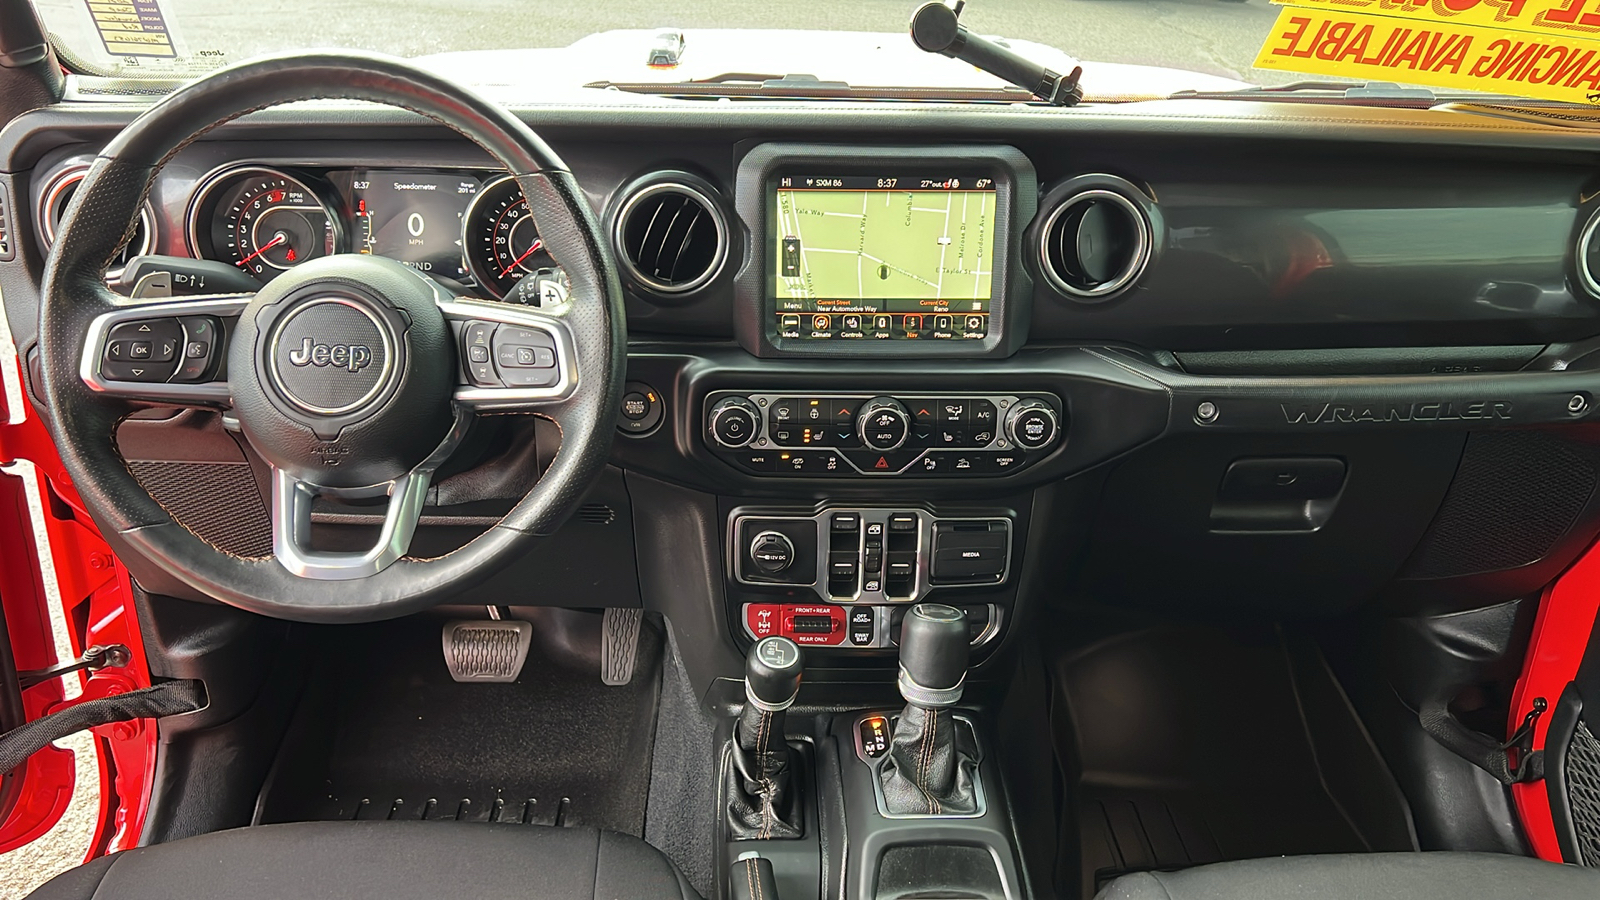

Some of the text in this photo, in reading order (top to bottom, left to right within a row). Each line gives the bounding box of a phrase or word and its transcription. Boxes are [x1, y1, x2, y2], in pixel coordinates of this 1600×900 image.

[354, 181, 370, 189] 8:37
[393, 182, 437, 191] Speedometer
[781, 178, 792, 187] HI
[816, 179, 842, 187] SXM 86
[877, 179, 897, 188] 8:37
[266, 194, 273, 202] 6
[507, 210, 518, 218] 40
[810, 208, 825, 217] Way
[407, 212, 425, 237] 0
[240, 225, 247, 233] 3
[255, 265, 263, 273] 0
[784, 302, 802, 310] Menu
[289, 337, 372, 373] Jeep
[977, 411, 990, 419] A/C
[1280, 401, 1514, 424] WRANGLER
